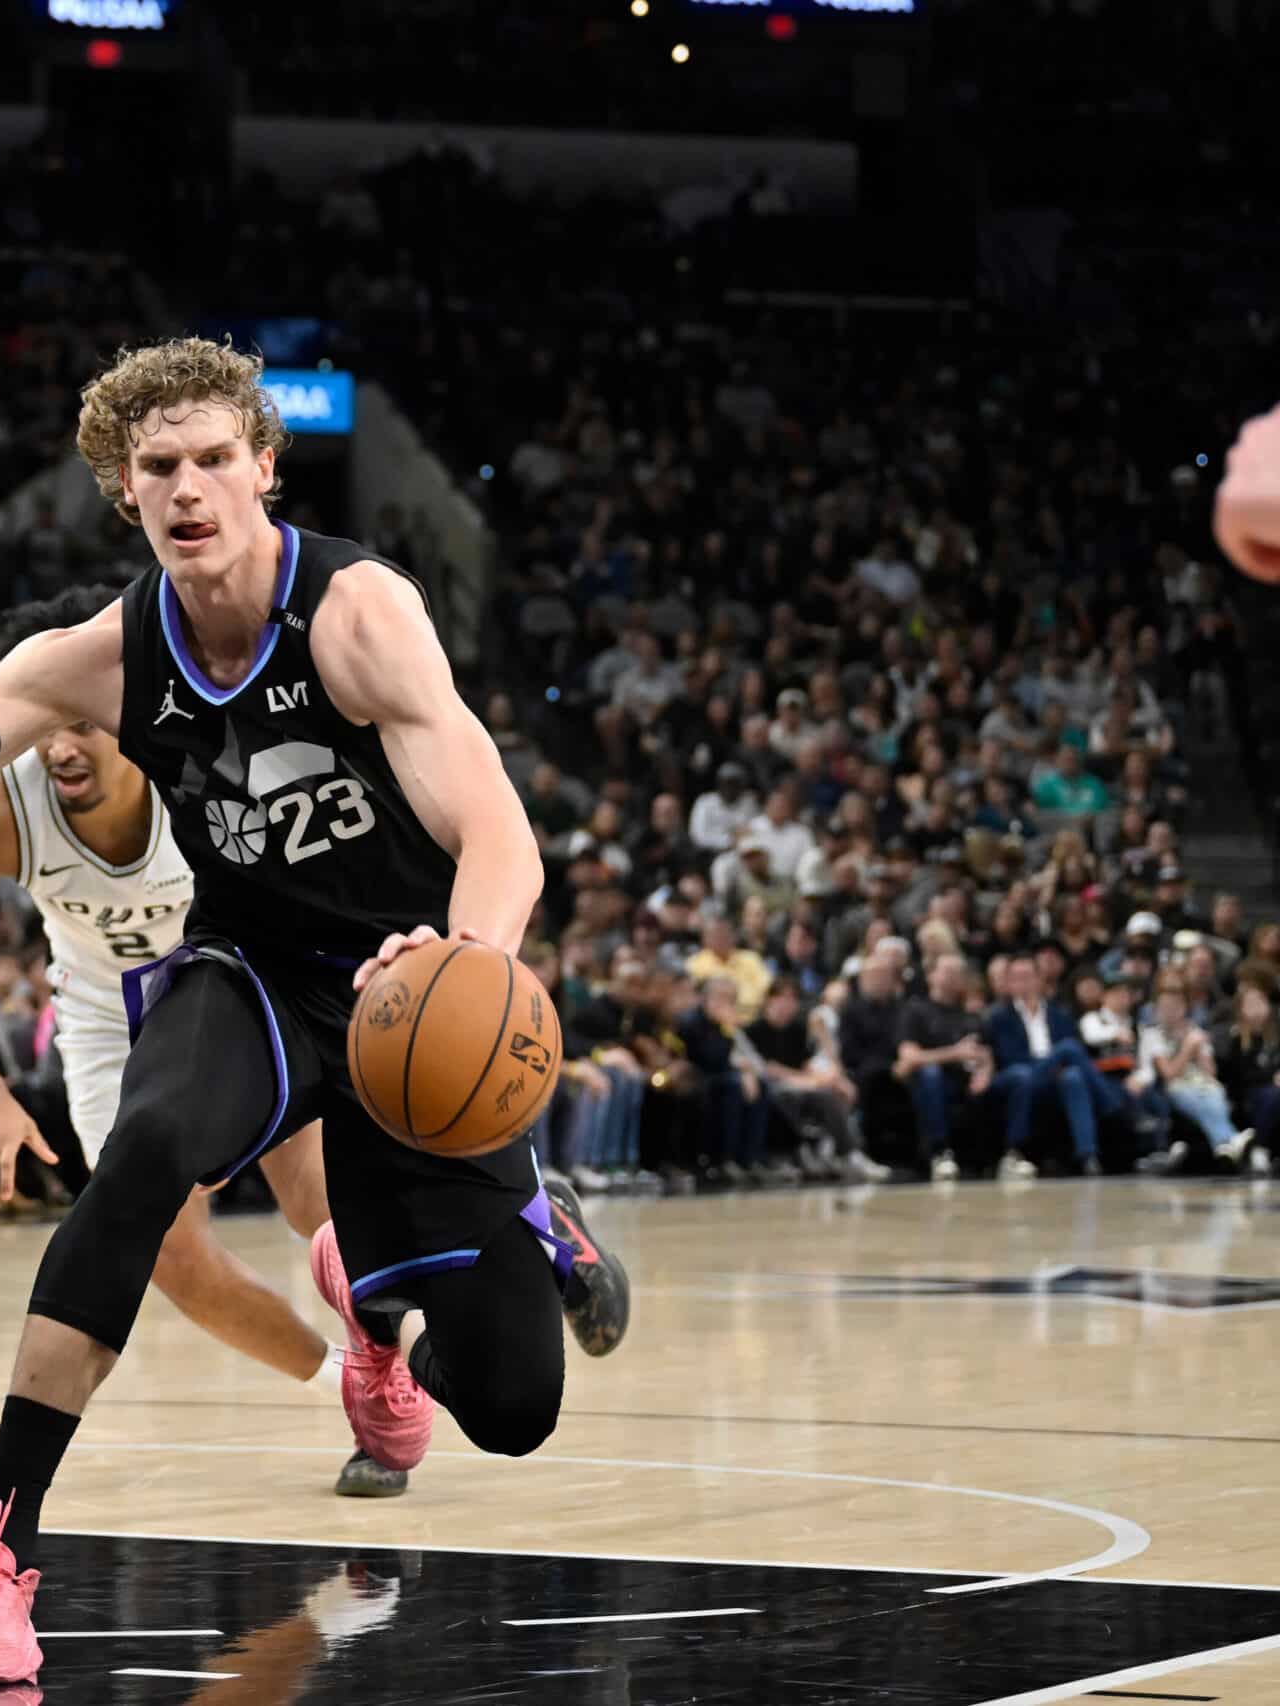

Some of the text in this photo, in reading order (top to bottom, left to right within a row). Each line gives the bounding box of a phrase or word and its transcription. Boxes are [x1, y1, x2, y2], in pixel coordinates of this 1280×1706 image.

[265, 680, 310, 713] LVT
[268, 778, 376, 865] 23
[104, 930, 158, 960] 2
